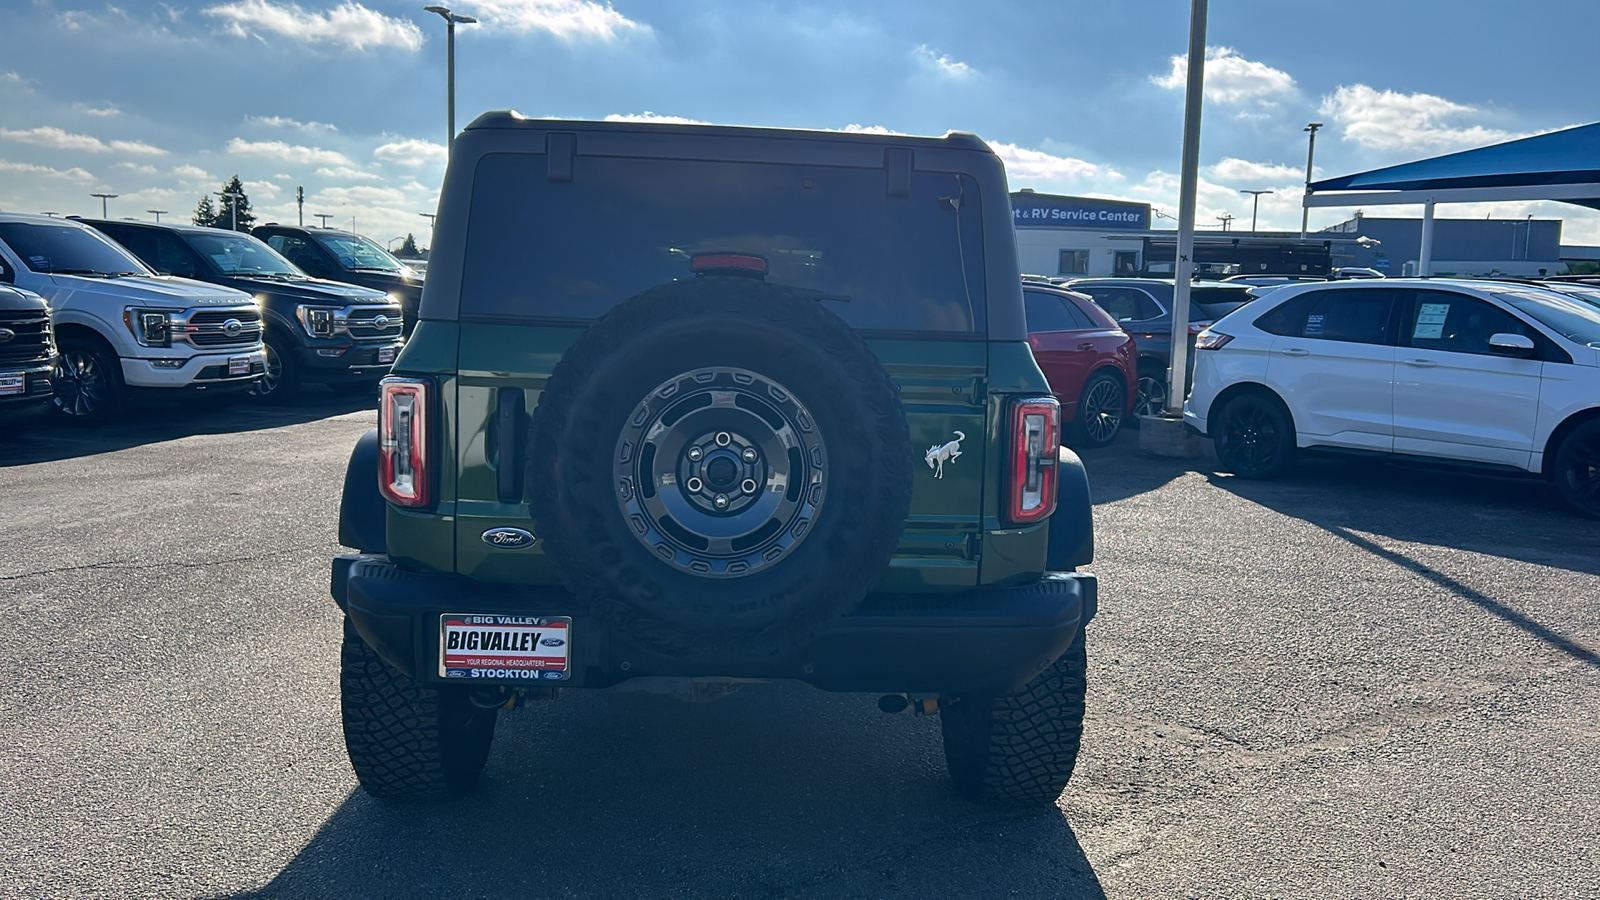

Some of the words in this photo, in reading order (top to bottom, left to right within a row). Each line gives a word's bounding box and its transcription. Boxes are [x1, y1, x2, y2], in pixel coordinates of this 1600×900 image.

[1032, 208, 1049, 219] RV
[1052, 208, 1096, 220] Service
[1099, 210, 1140, 222] Center
[497, 616, 540, 624] VALLEY
[447, 631, 542, 652] BIGVALLEY
[470, 669, 538, 678] STOCKTON
